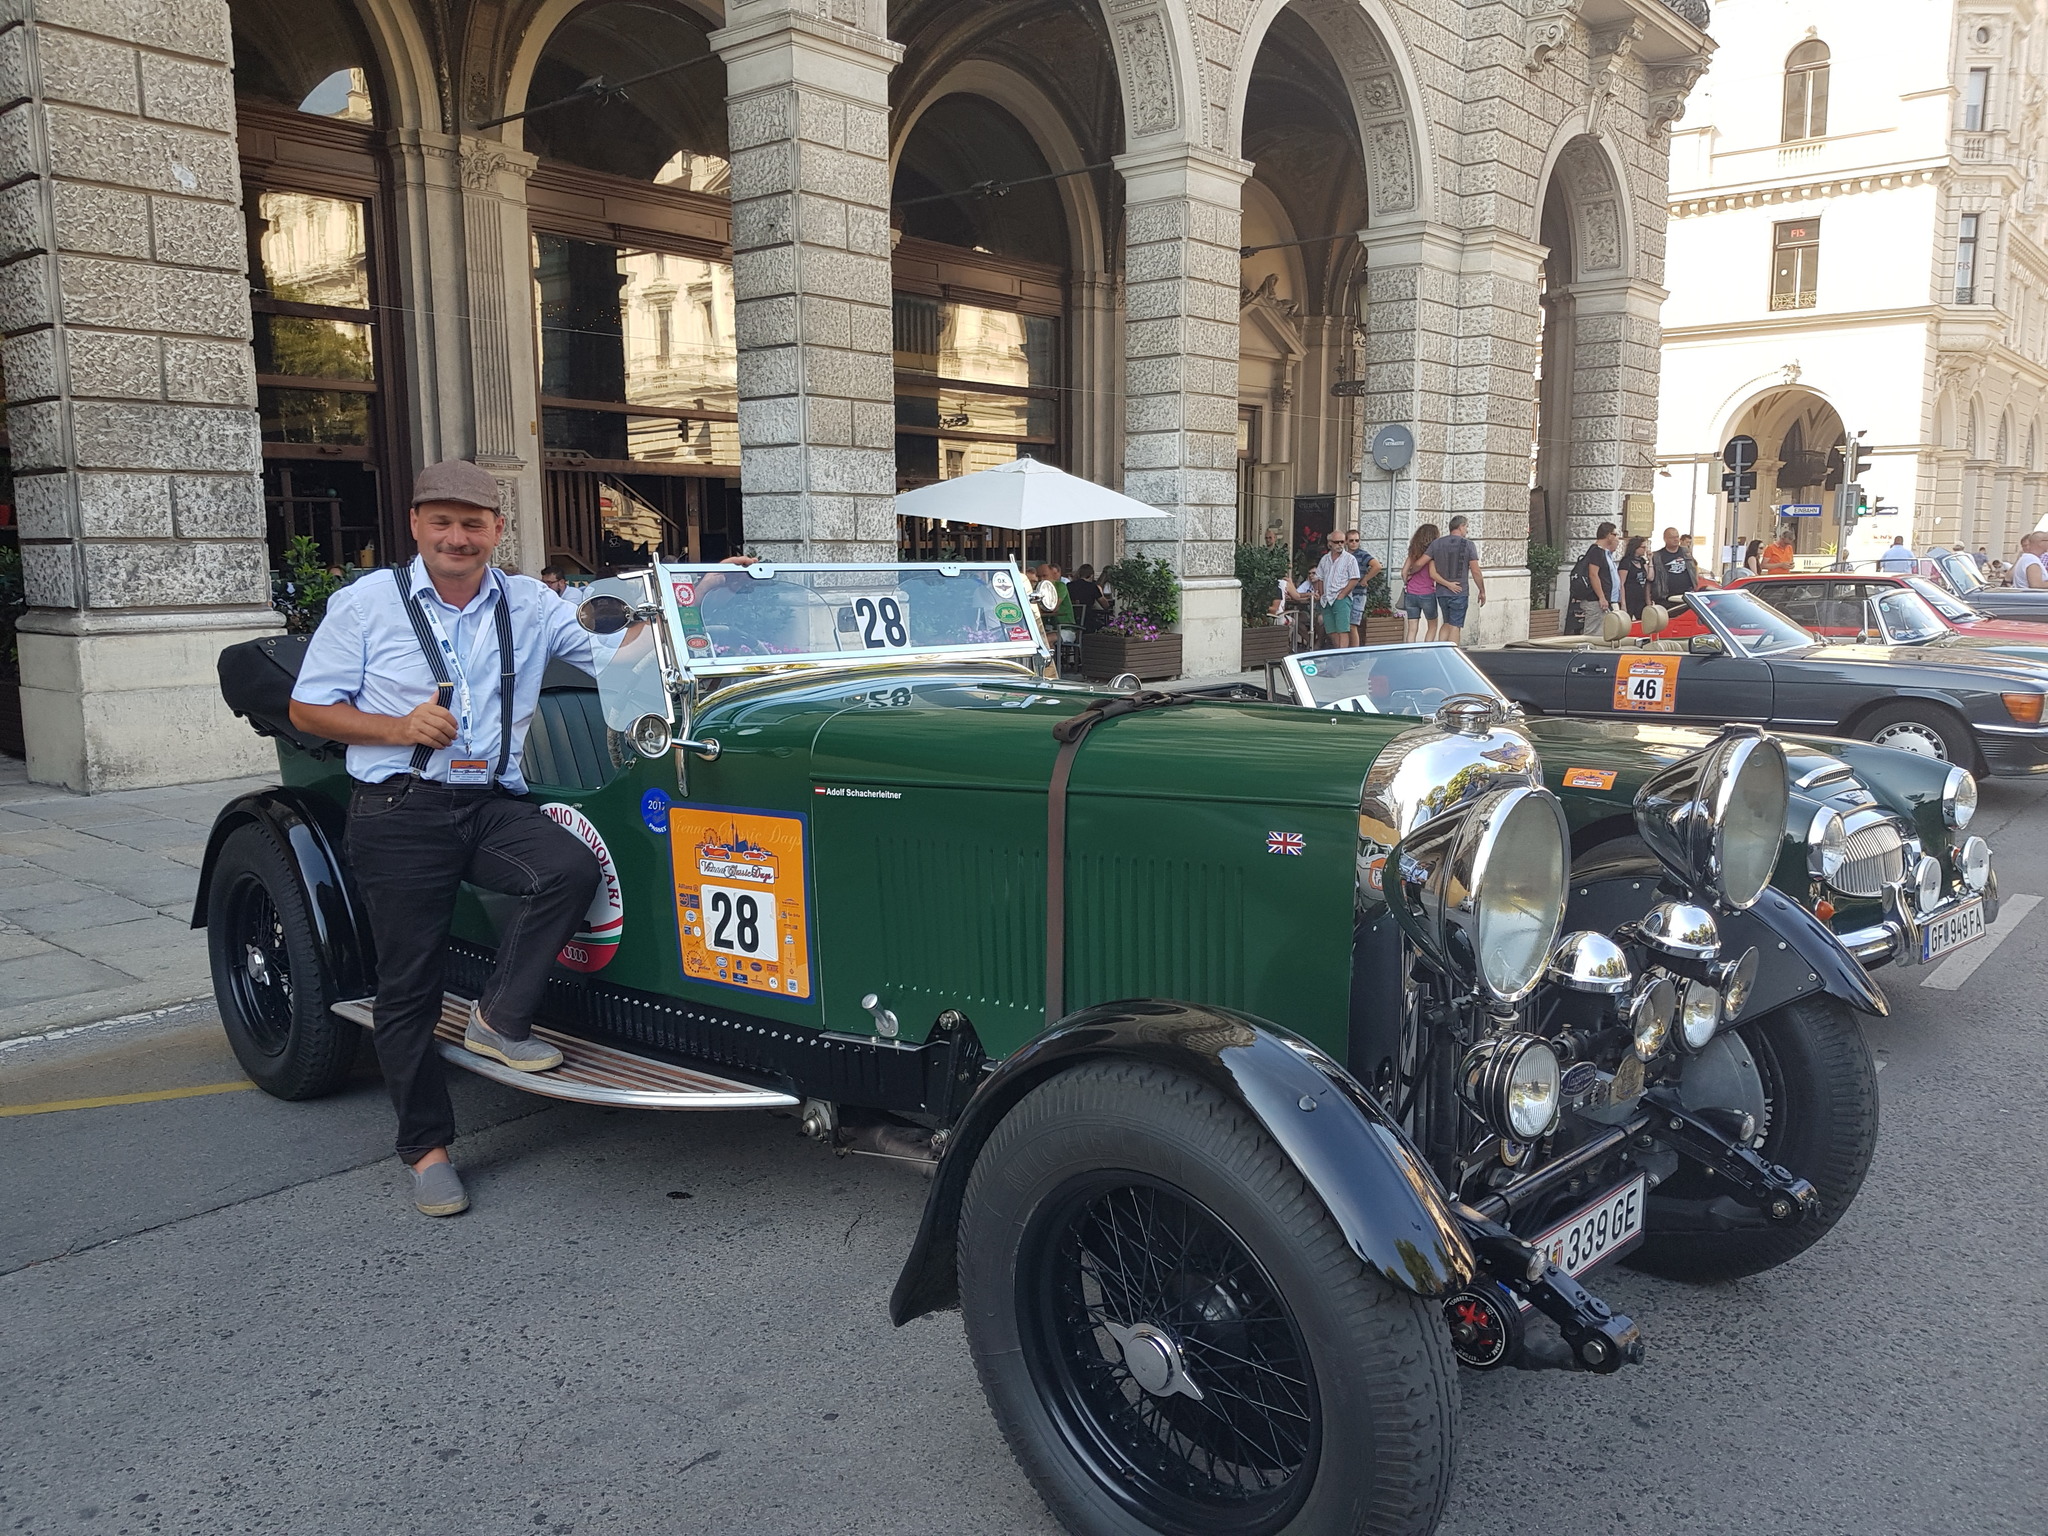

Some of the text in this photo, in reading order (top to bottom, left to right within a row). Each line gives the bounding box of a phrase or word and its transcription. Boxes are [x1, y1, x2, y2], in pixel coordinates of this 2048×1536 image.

[1790, 228, 1806, 238] FIS
[1957, 261, 1971, 271] FIS
[1630, 501, 1653, 513] EINSTEIN
[1793, 506, 1818, 514] EINBAHN
[855, 597, 907, 649] 28
[1633, 679, 1657, 700] 46
[826, 787, 902, 799] Adolf Schacherleitner
[576, 817, 621, 910] NUVOLARI
[711, 891, 760, 953] 28
[1931, 923, 1943, 953] GF
[1003, 1127, 1184, 1193] MICHELIN
